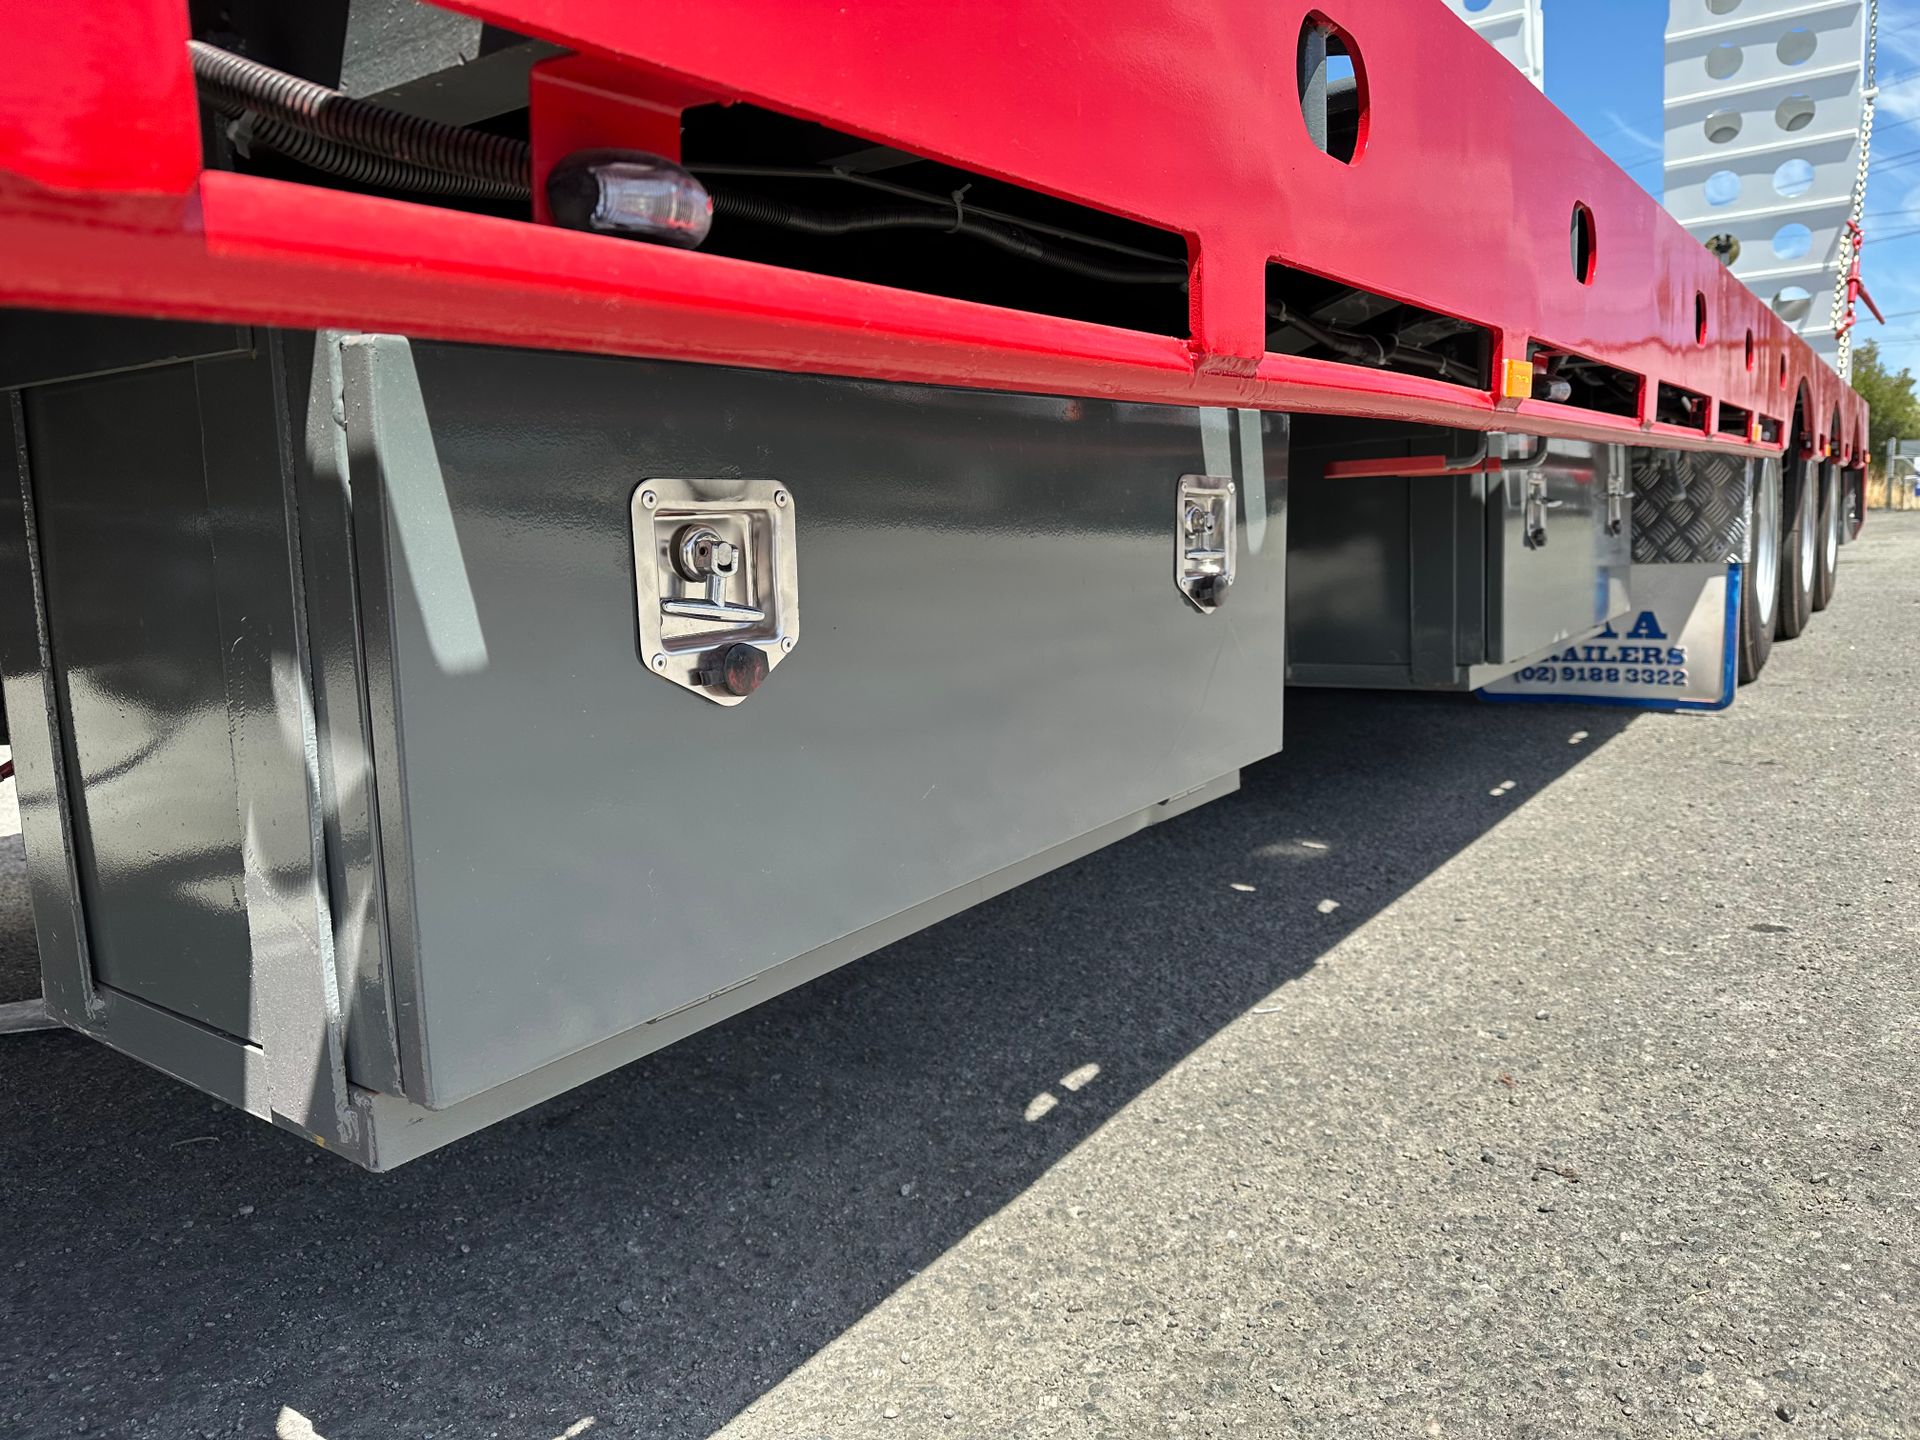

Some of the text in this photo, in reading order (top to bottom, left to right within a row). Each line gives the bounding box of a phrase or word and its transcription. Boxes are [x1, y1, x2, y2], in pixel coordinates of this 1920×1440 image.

[1514, 667, 1688, 686] (02) 9188 3322
